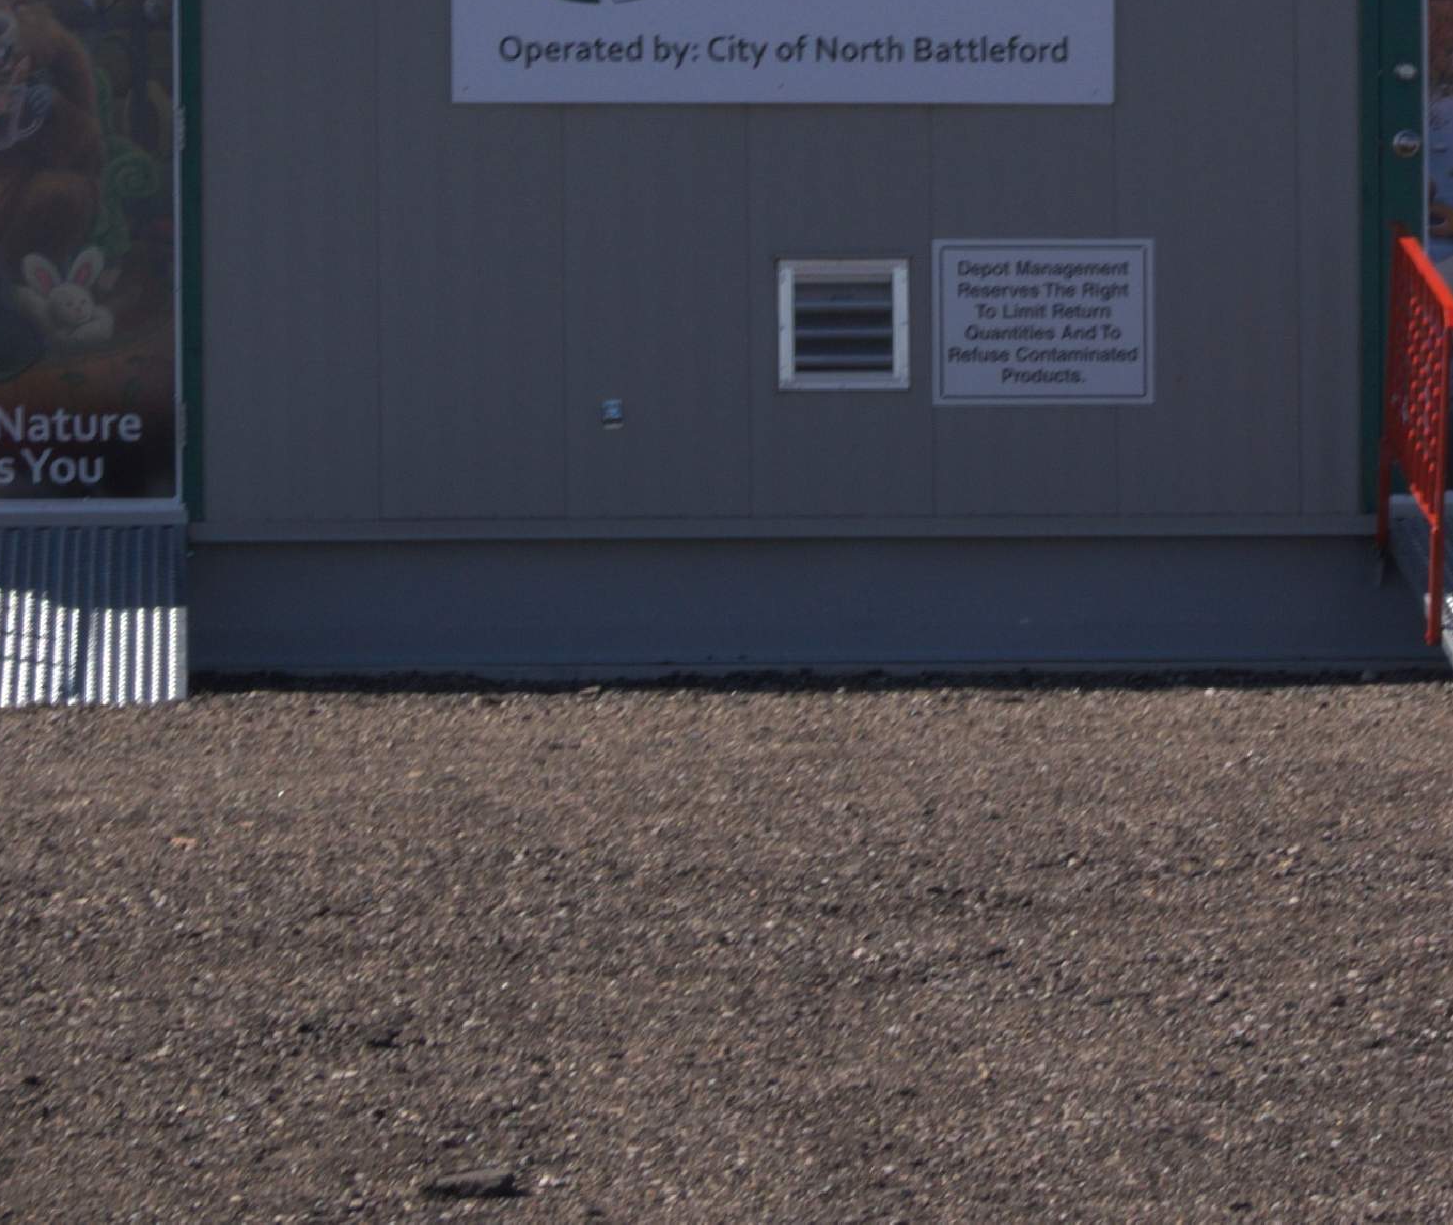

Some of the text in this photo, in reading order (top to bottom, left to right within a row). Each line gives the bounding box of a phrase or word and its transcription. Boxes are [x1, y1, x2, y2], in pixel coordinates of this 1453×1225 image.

[499, 35, 1068, 68] Operated by: City of North Battleford
[958, 261, 1128, 279] Depot Management
[958, 282, 1128, 300] Reserves The Right
[977, 304, 1111, 319] To Limit Return
[965, 325, 1121, 340] Quantities And To
[948, 347, 1137, 362] Refuse Contaminated
[1002, 368, 1087, 383] Products.
[21, 449, 103, 484] You
